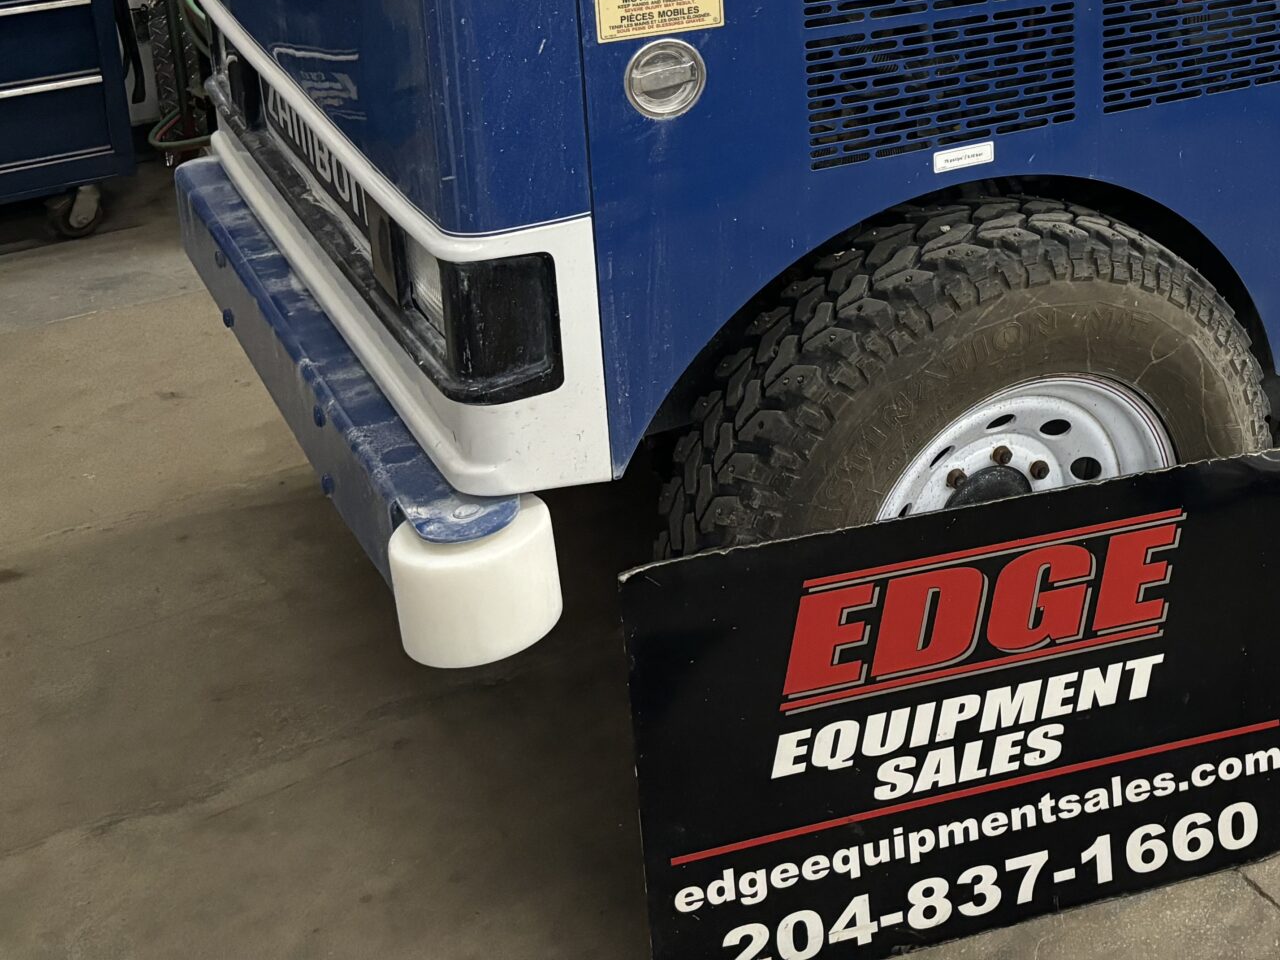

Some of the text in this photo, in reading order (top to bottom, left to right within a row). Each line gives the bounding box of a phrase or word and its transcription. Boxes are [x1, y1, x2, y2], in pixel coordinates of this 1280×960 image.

[620, 6, 699, 23] PIÈCES MOBILES
[783, 524, 1180, 698] EDGE
[771, 653, 1165, 780] EQUIPMENT
[873, 723, 1065, 801] SALES
[722, 801, 1259, 960] 204-837-1660
